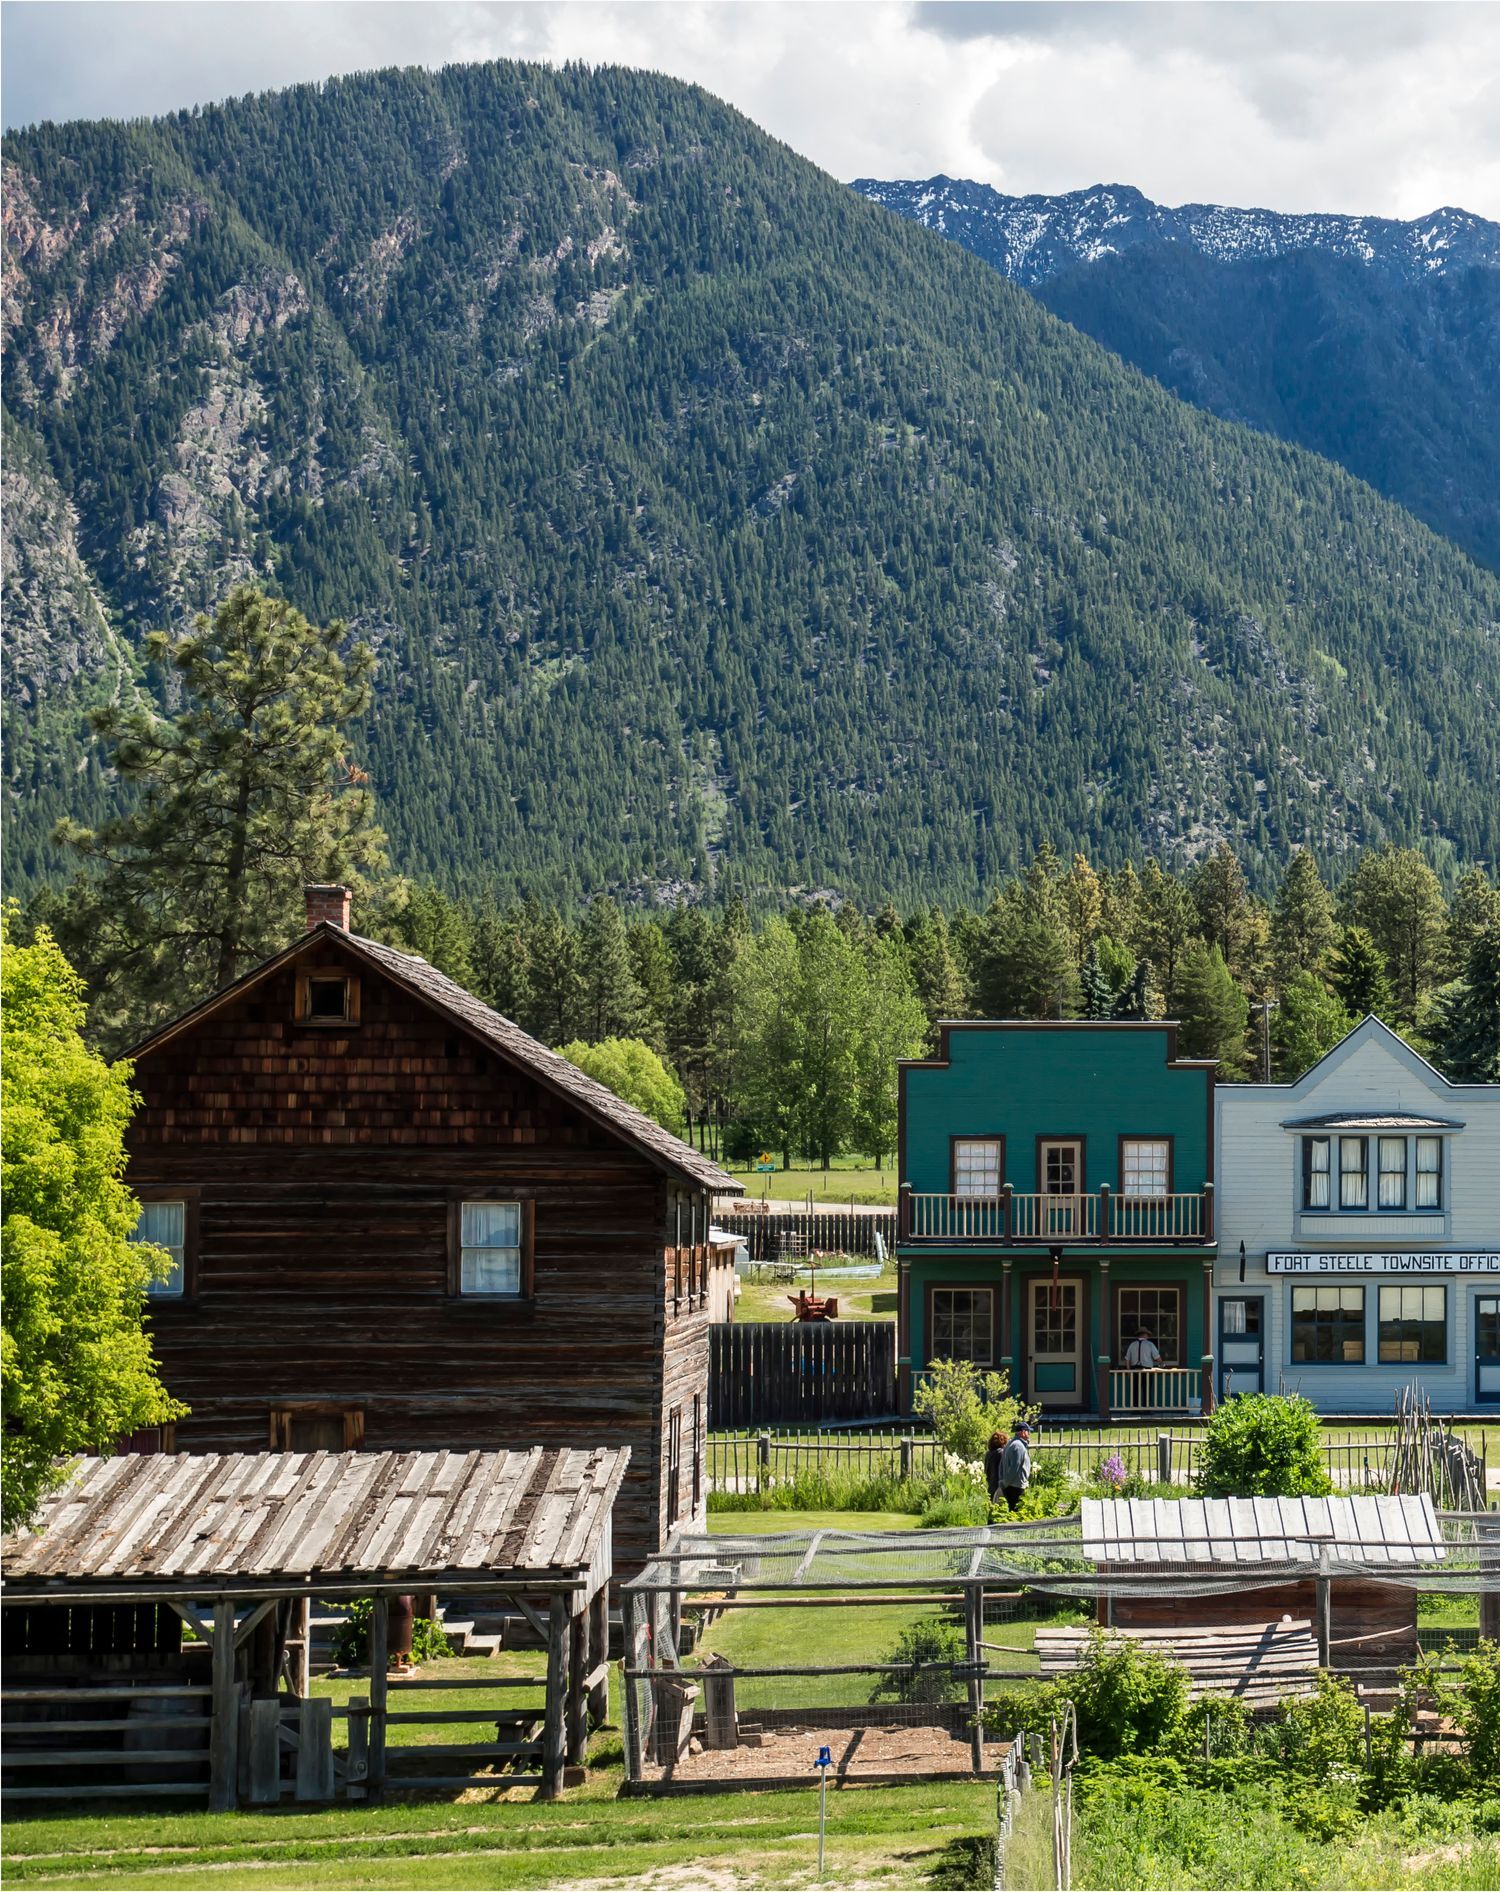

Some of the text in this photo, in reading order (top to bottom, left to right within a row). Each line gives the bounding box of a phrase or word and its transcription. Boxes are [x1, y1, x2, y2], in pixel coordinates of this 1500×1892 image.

[1275, 1256, 1311, 1270] FORT
[1319, 1256, 1373, 1270] STEELE
[1381, 1256, 1452, 1270] TOWNSITE
